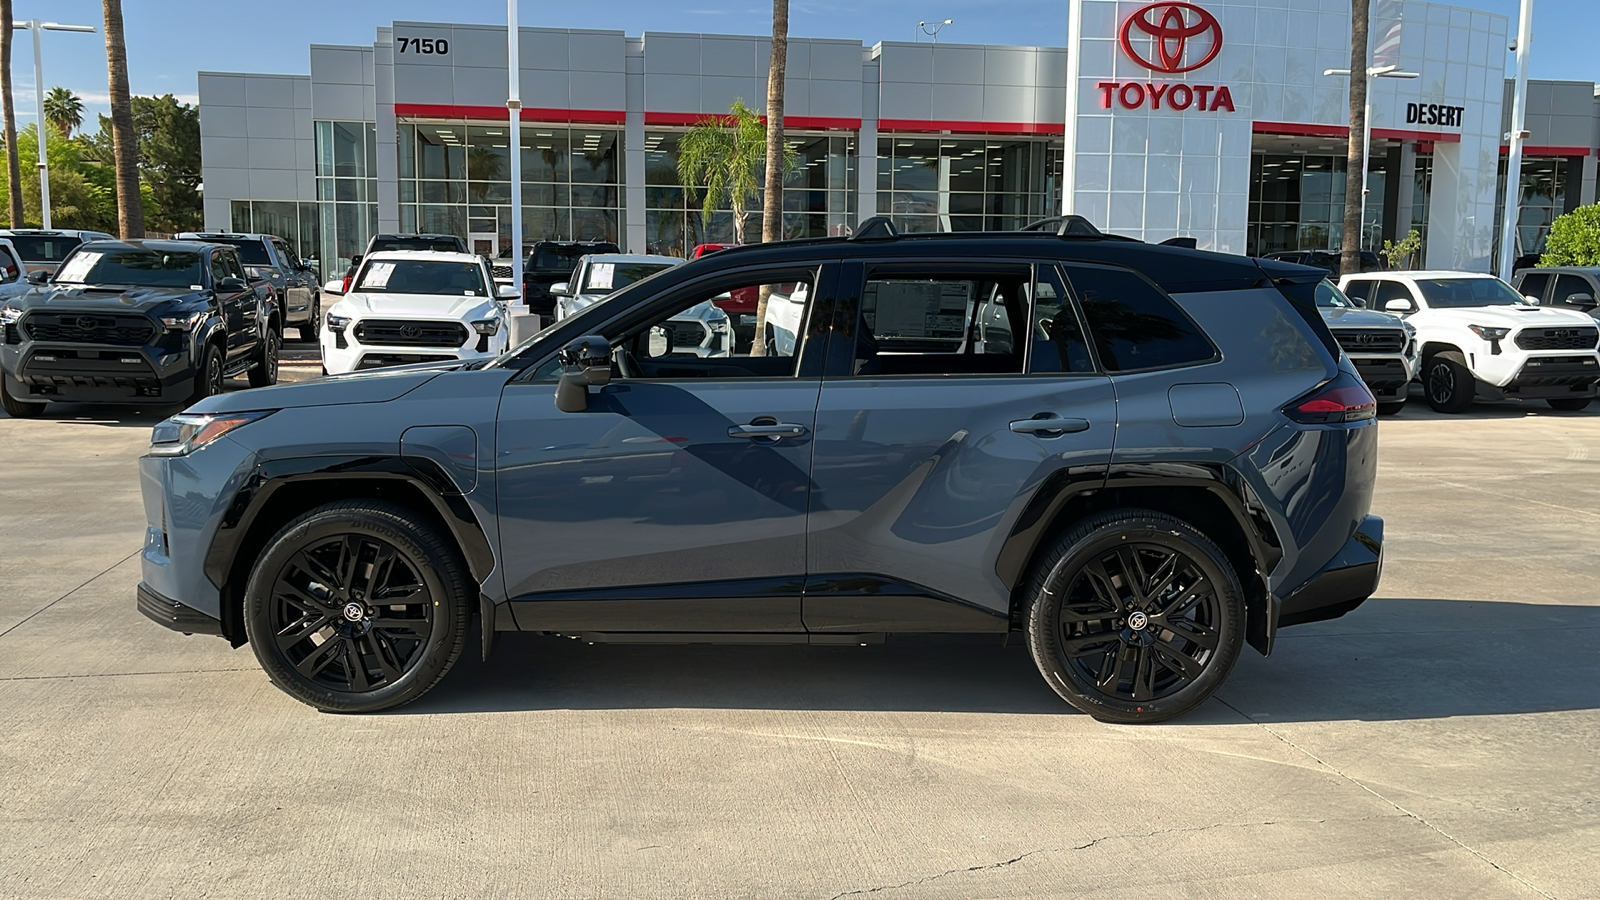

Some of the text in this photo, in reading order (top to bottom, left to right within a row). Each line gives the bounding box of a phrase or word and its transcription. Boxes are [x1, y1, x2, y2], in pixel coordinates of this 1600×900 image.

[397, 38, 449, 55] 7150
[1098, 82, 1235, 112] TOYOTA
[1406, 103, 1464, 127] DESERT
